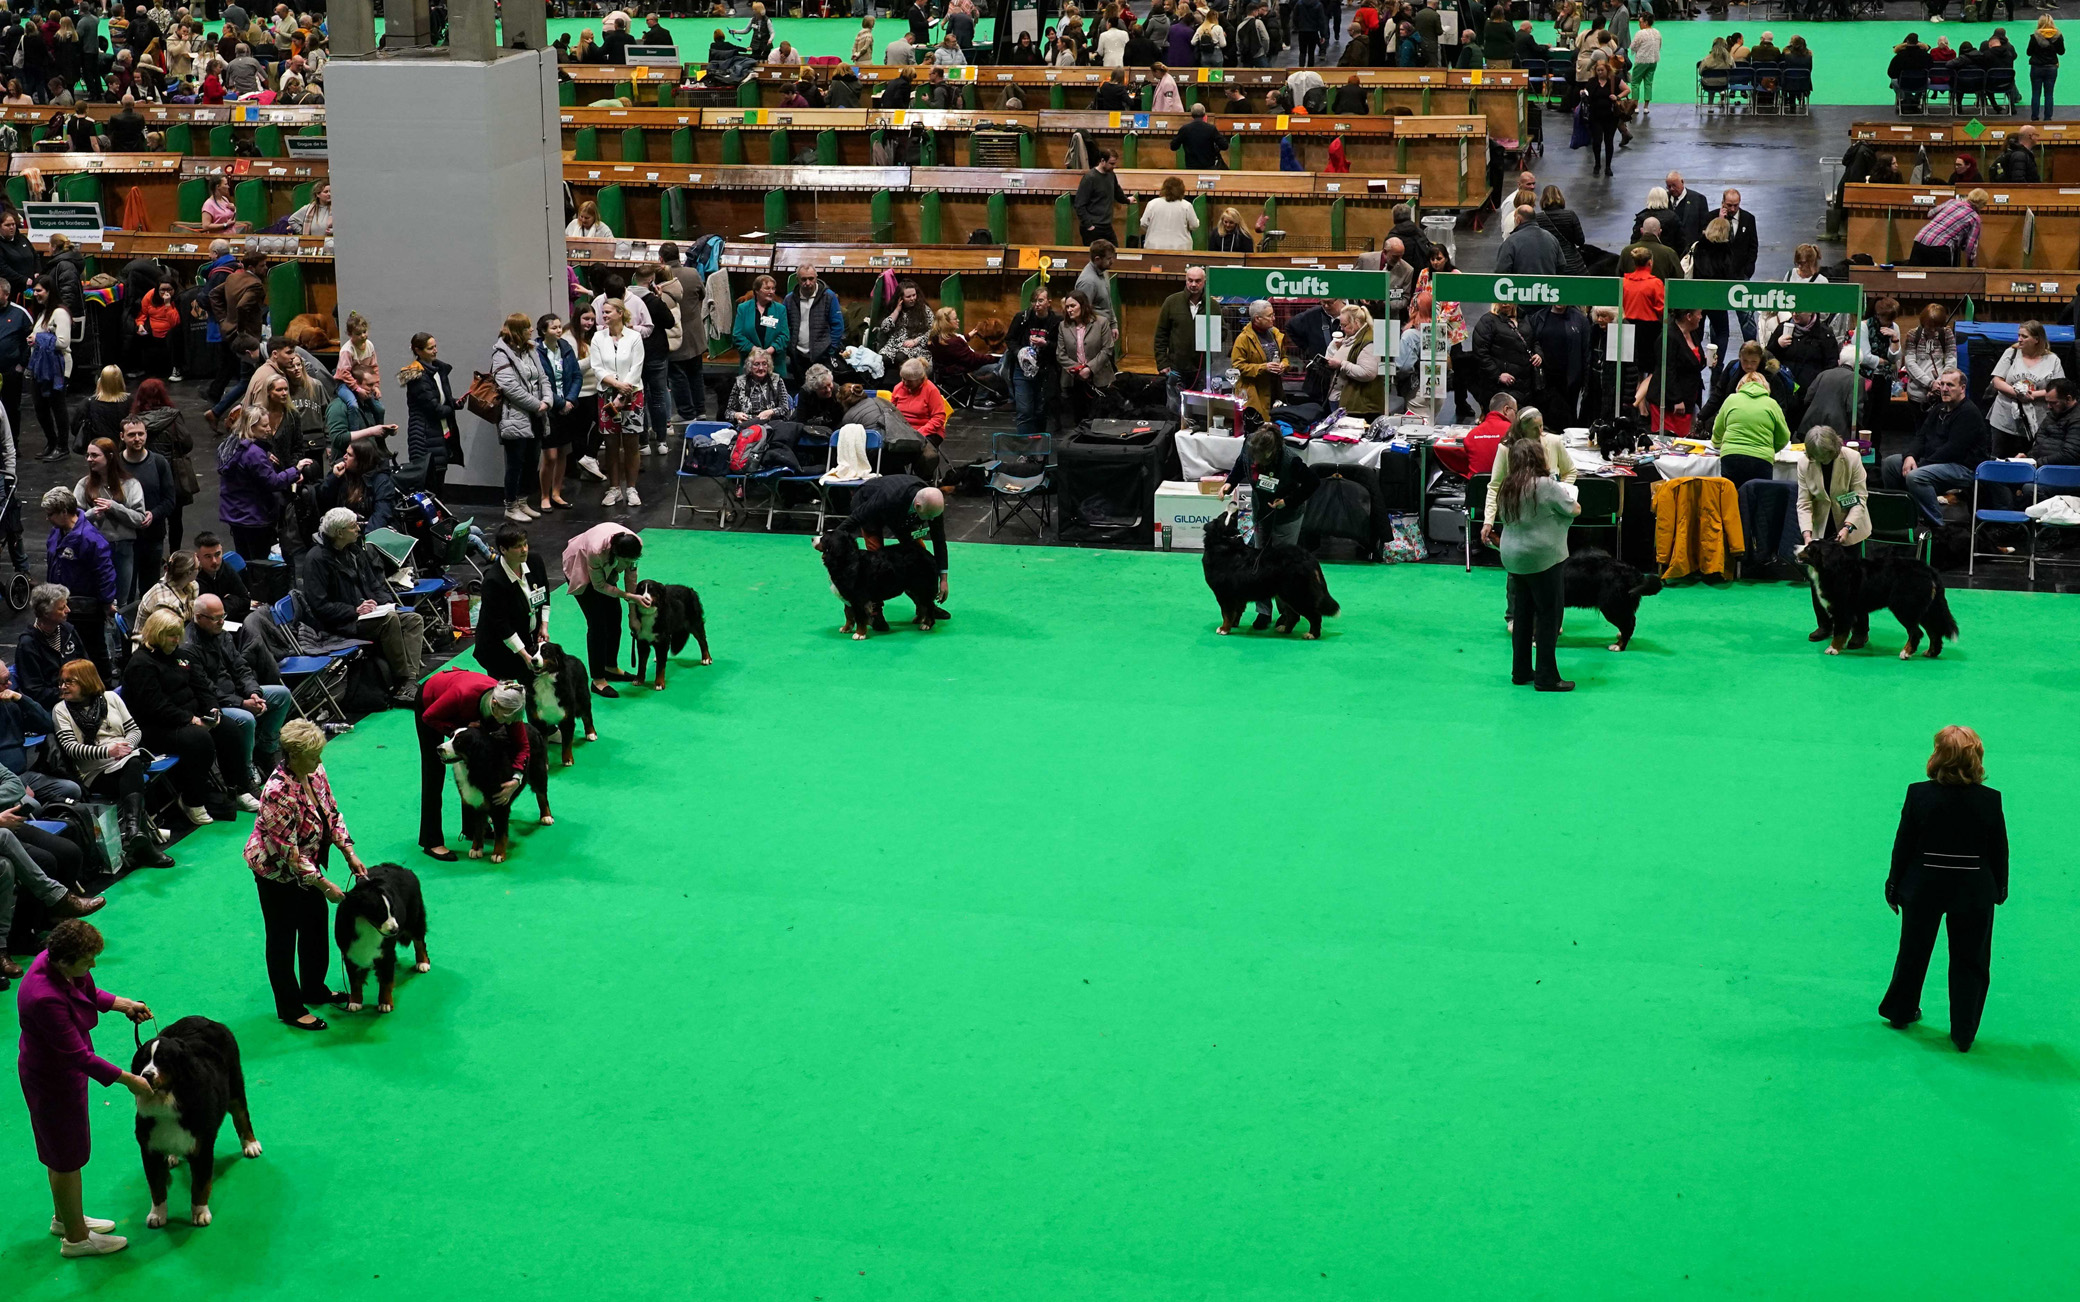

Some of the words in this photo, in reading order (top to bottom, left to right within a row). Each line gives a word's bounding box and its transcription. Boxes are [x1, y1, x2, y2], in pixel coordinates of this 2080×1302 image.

[1266, 271, 1329, 296] Crufts
[1494, 277, 1560, 303] Crufts
[1728, 284, 1796, 309] Crufts
[1174, 514, 1210, 523] GILDAN
